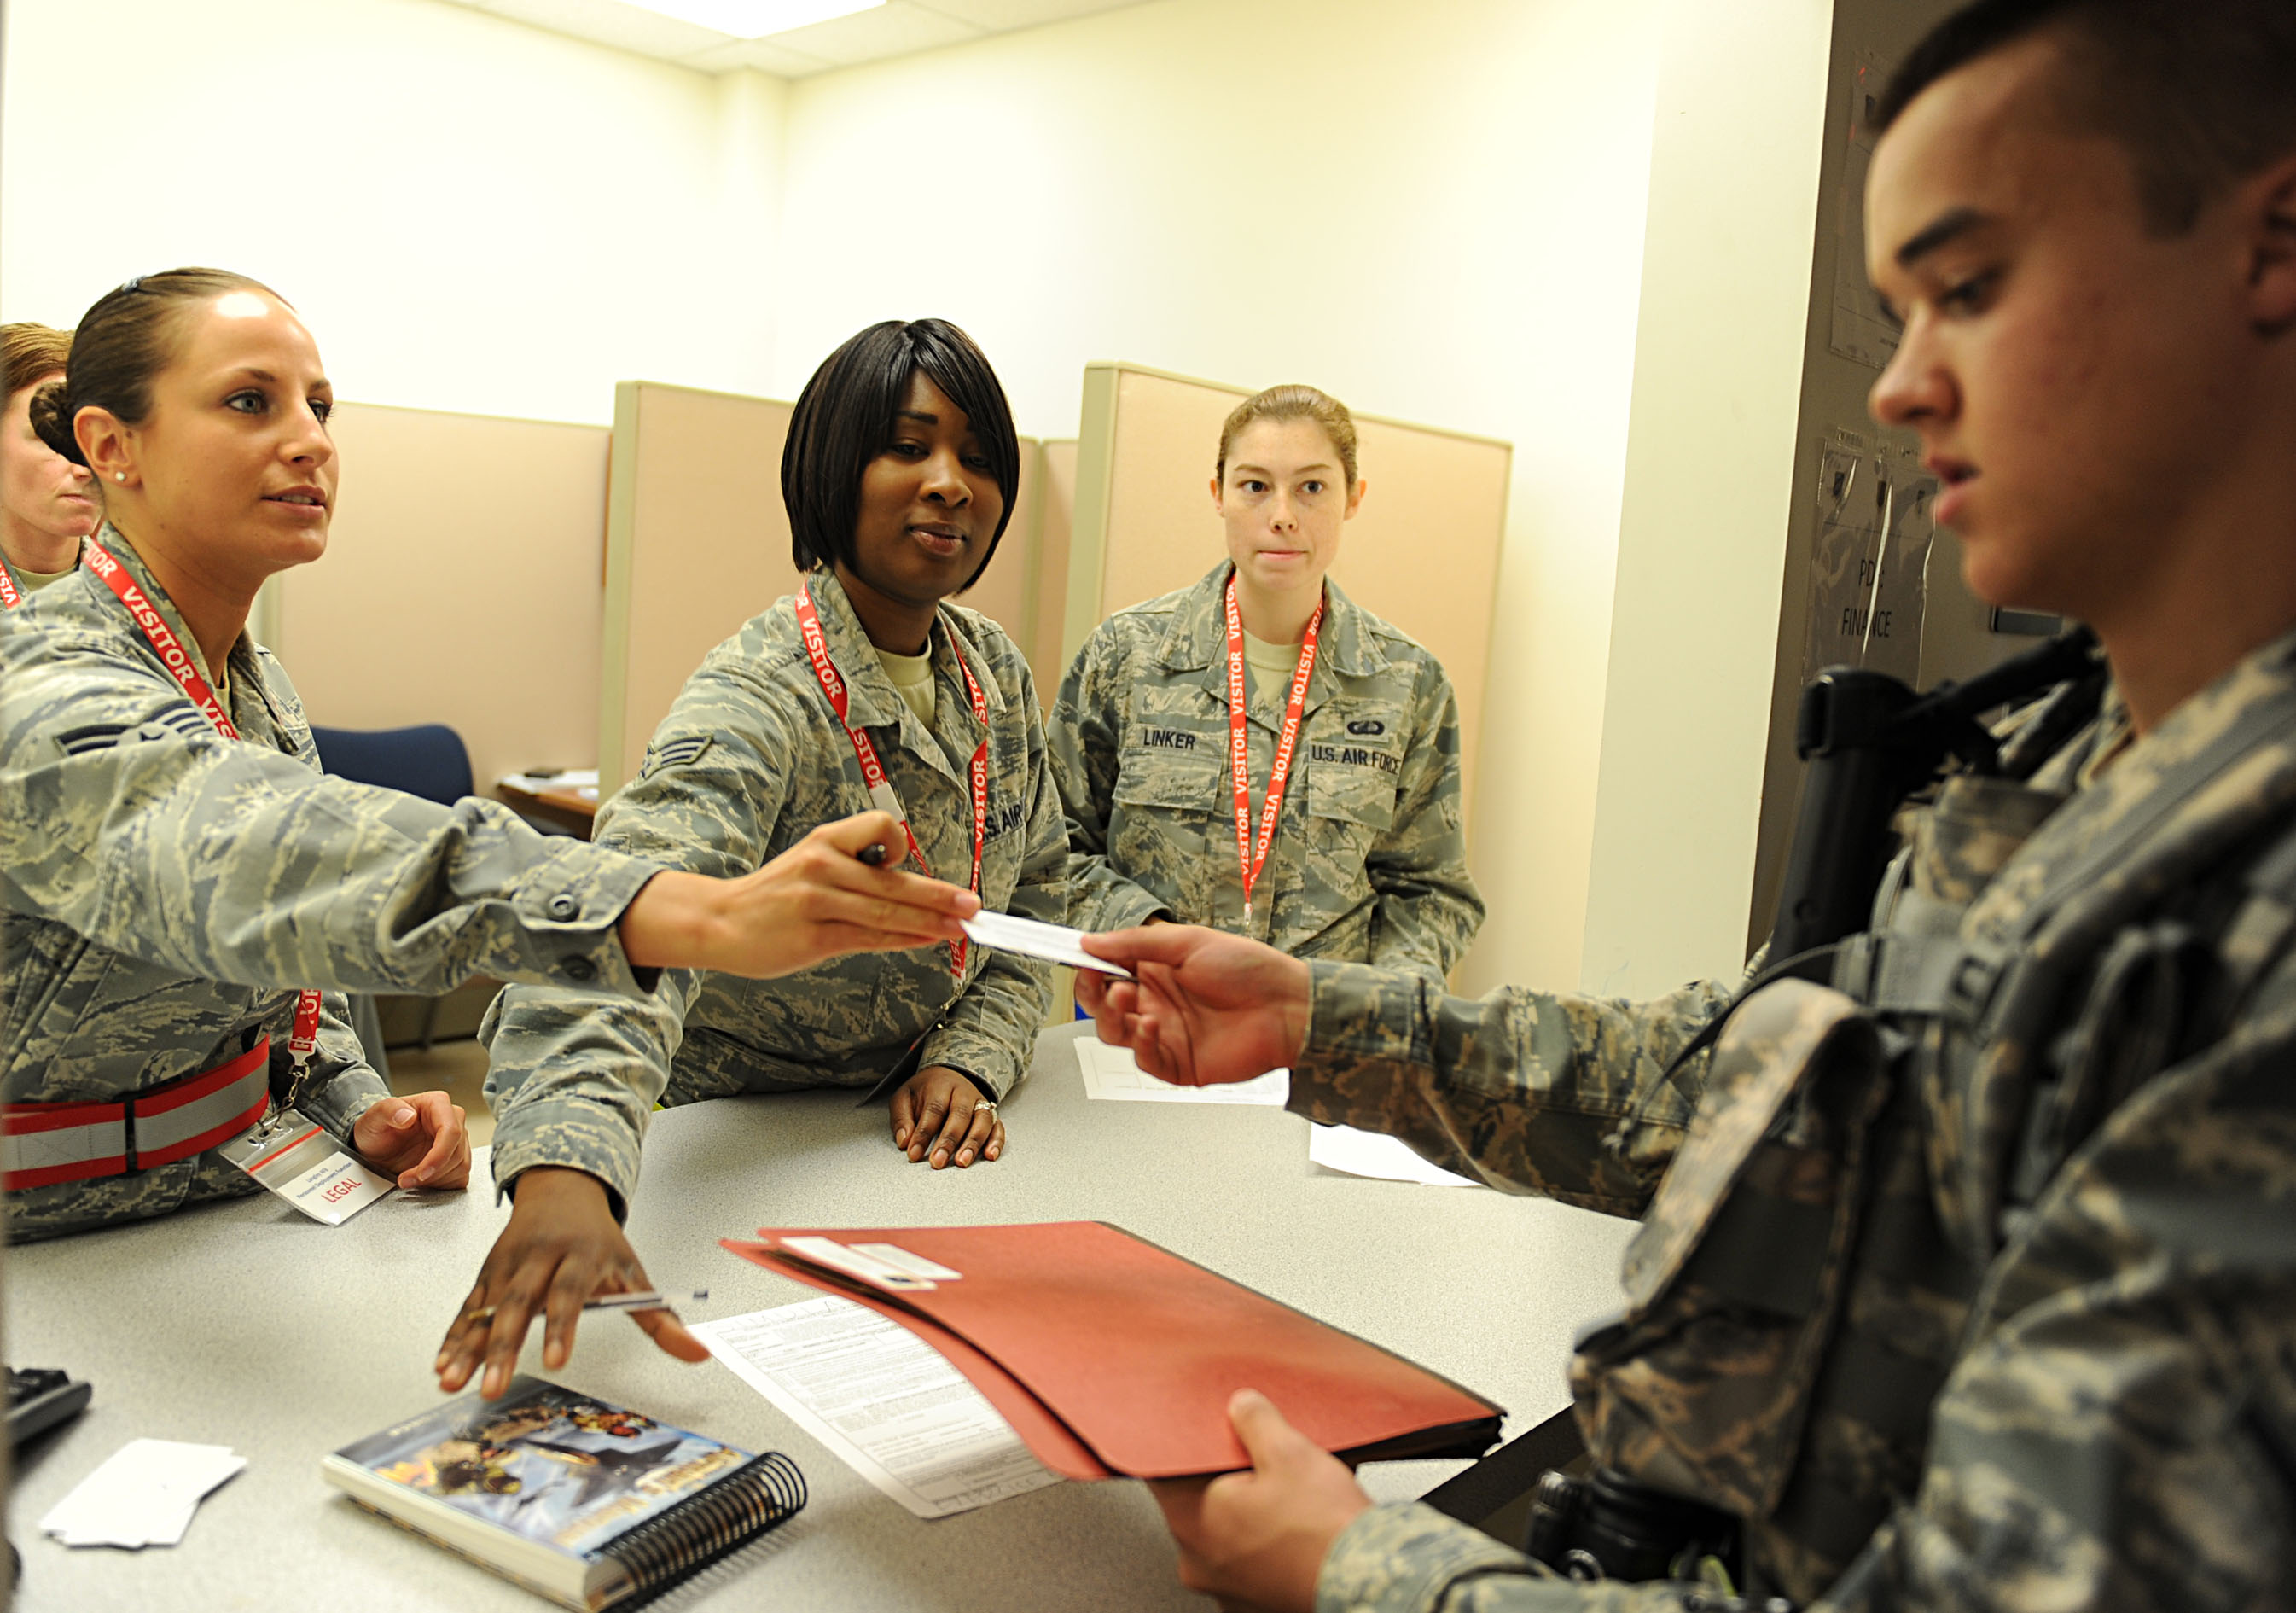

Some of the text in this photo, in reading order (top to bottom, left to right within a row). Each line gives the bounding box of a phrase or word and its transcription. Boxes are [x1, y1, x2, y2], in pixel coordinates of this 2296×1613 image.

[1858, 558, 1885, 589] PD:
[123, 586, 195, 684] VISITOR
[1841, 607, 1893, 638] FINANCE
[803, 617, 843, 700] VISITOR
[1230, 651, 1244, 715] VISITOR
[1291, 644, 1315, 705] VISITOR
[1143, 729, 1195, 751] LINKER
[1234, 727, 1247, 795] VISITOR
[1271, 718, 1298, 782] VISITOR
[1312, 744, 1402, 776] U.S. AIR FORCE
[973, 760, 985, 843] VISITOR
[1002, 803, 1023, 832] AIR
[1255, 795, 1279, 860] VISITOR
[1238, 807, 1249, 875] VISITOR
[321, 1177, 363, 1203] LEGAL
